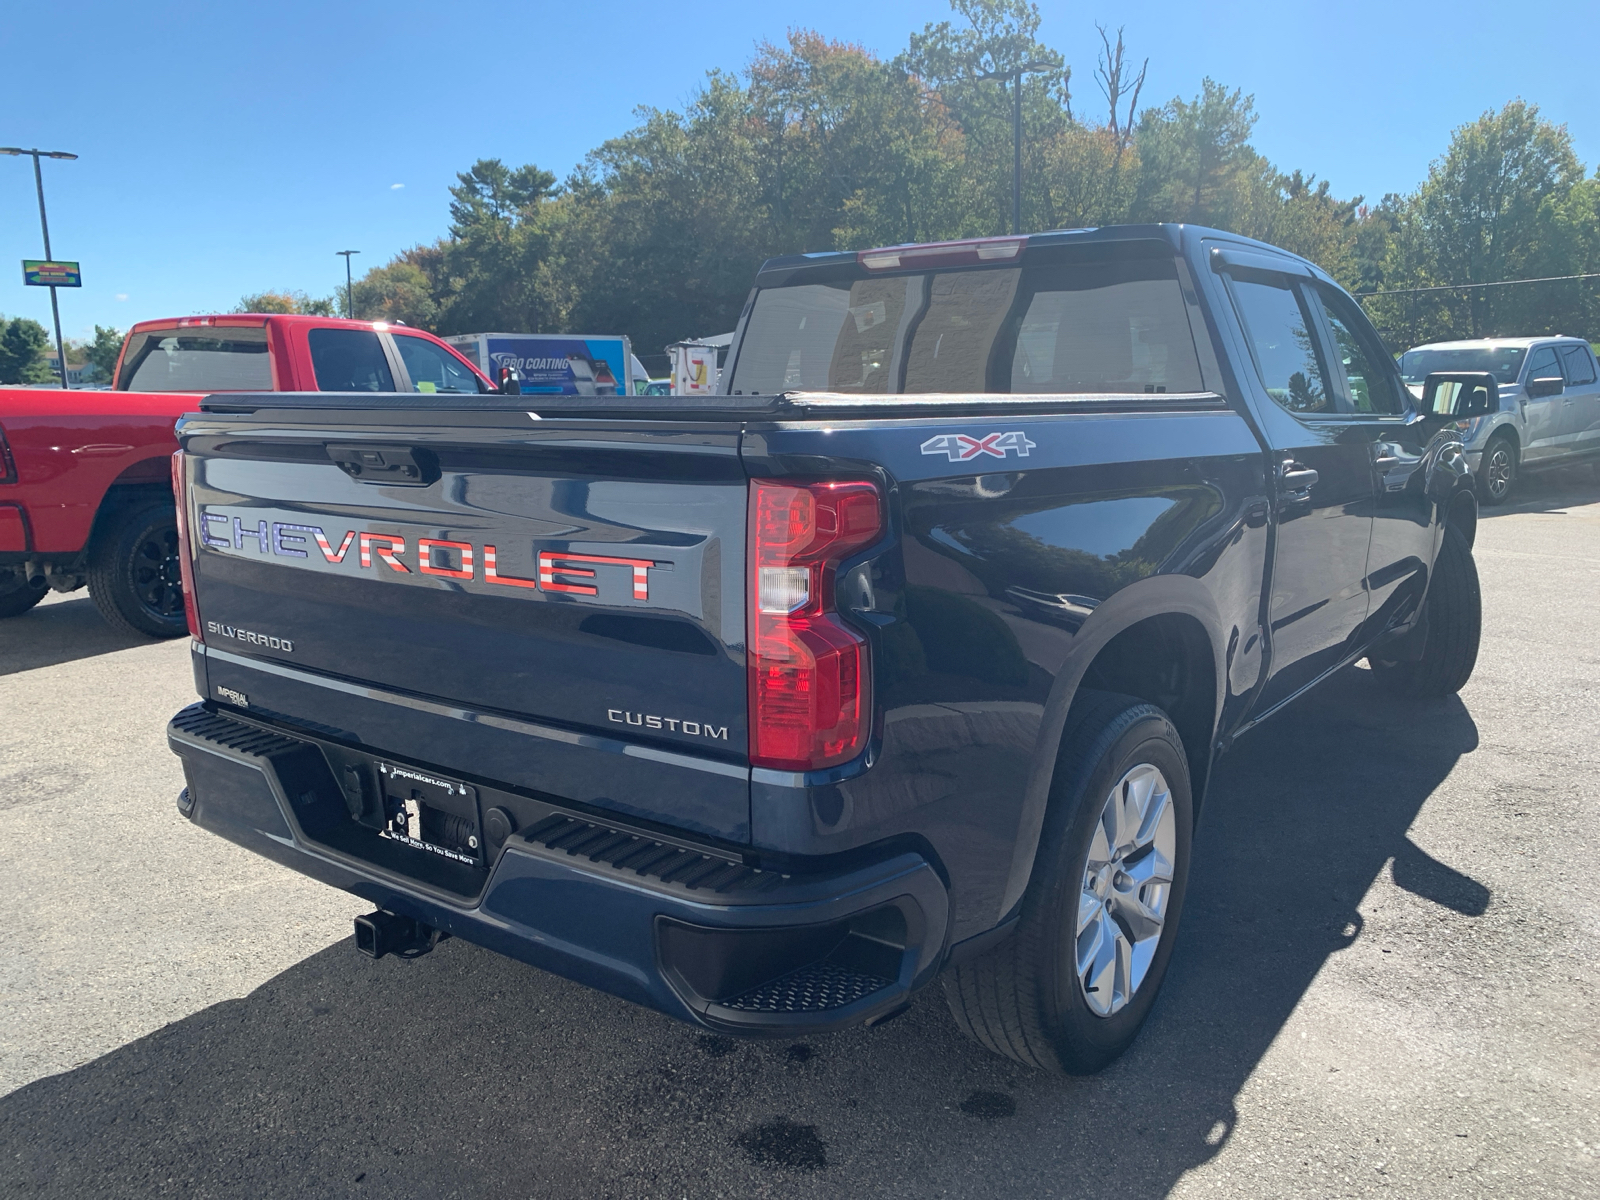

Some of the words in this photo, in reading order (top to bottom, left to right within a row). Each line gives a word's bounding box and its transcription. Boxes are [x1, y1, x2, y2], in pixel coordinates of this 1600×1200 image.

[502, 358, 524, 369] PRO
[526, 358, 569, 369] COATING
[201, 512, 675, 602] CHEVROLET
[207, 621, 294, 652] SILVERADO
[217, 685, 246, 702] IMPERIAL
[607, 708, 729, 741] CUSTOM
[391, 832, 400, 841] We
[400, 835, 410, 844] Sell
[425, 844, 433, 852] So
[433, 846, 444, 855] You
[444, 850, 458, 860] Save
[459, 855, 474, 865] More
